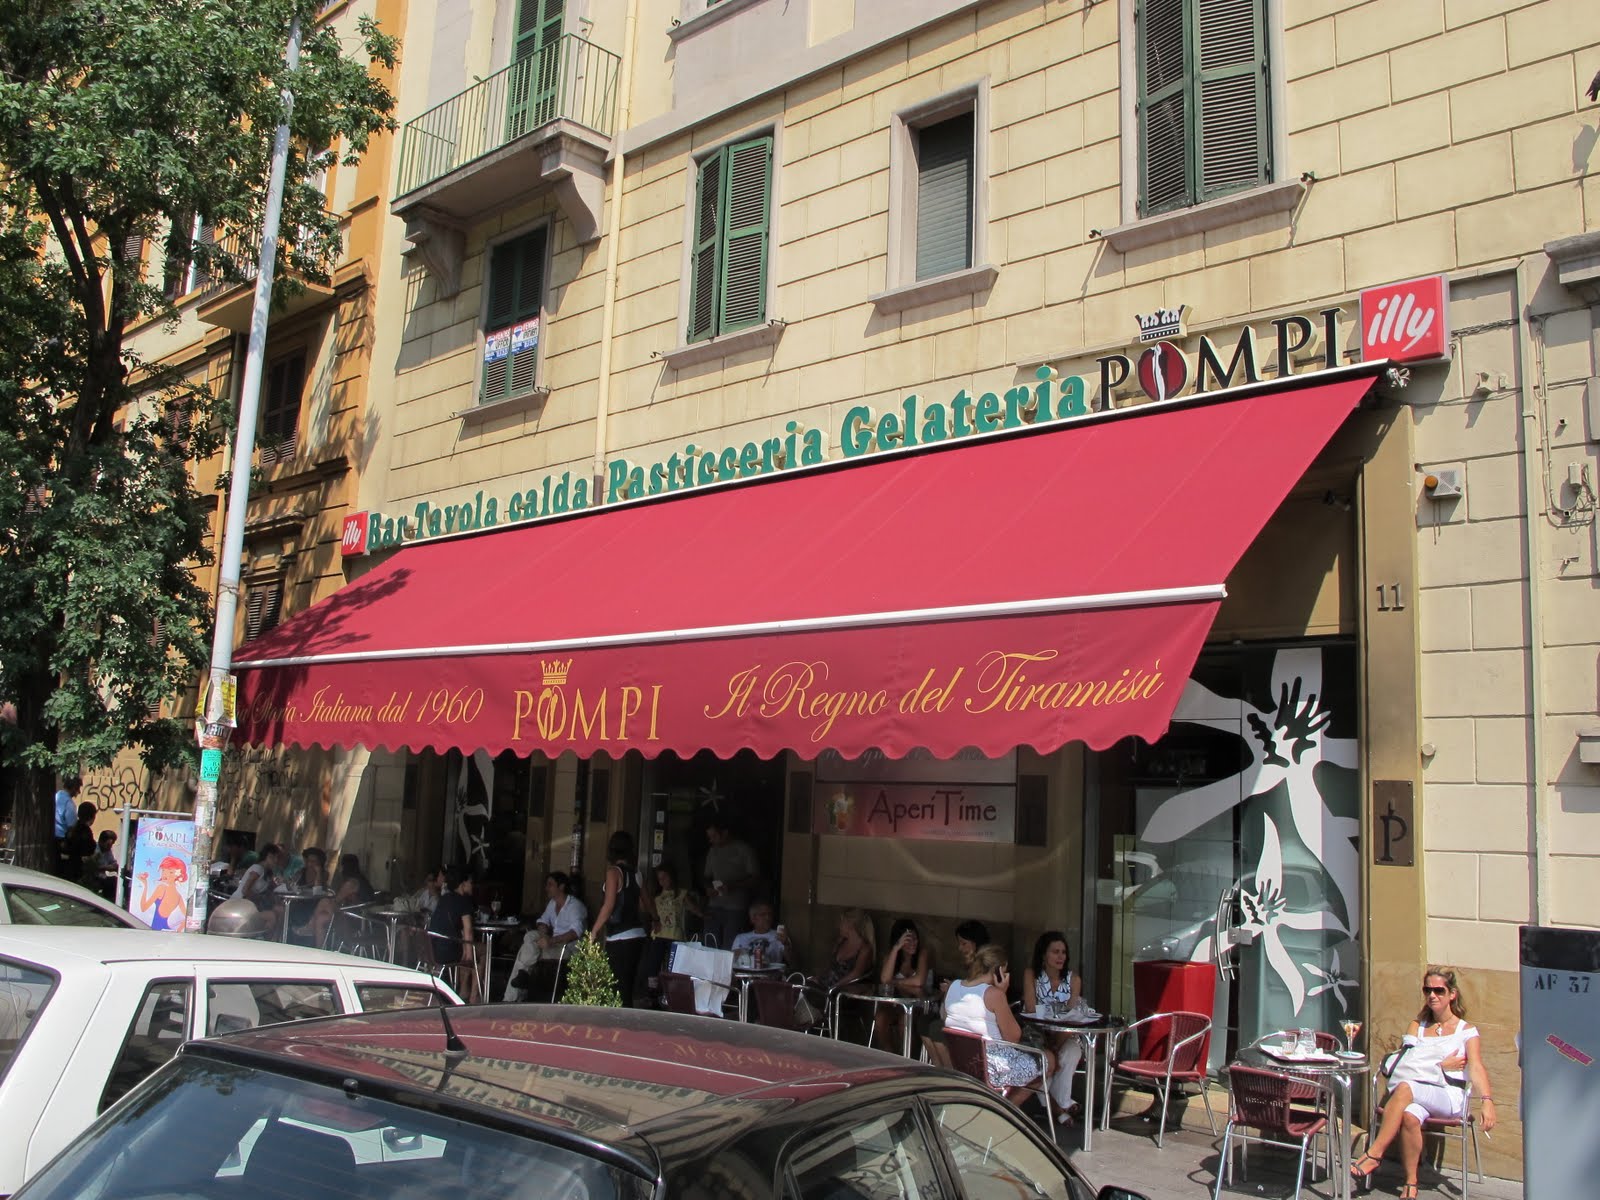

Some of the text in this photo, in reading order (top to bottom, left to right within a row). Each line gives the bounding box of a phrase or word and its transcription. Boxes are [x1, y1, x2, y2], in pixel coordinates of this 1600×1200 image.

[1367, 293, 1435, 352] illy
[1095, 307, 1342, 412] POMPI
[367, 365, 1088, 550] Bar Tavola calda Pasticceria Gelateria
[342, 520, 362, 551] illy
[1375, 583, 1406, 611] 11
[300, 684, 373, 723] Italiana
[377, 691, 413, 723] dal
[416, 685, 485, 725] 1960
[511, 685, 663, 741] POMPI
[703, 649, 1165, 743] Il Regno del Tiramisù
[1568, 976, 1591, 993] 37
